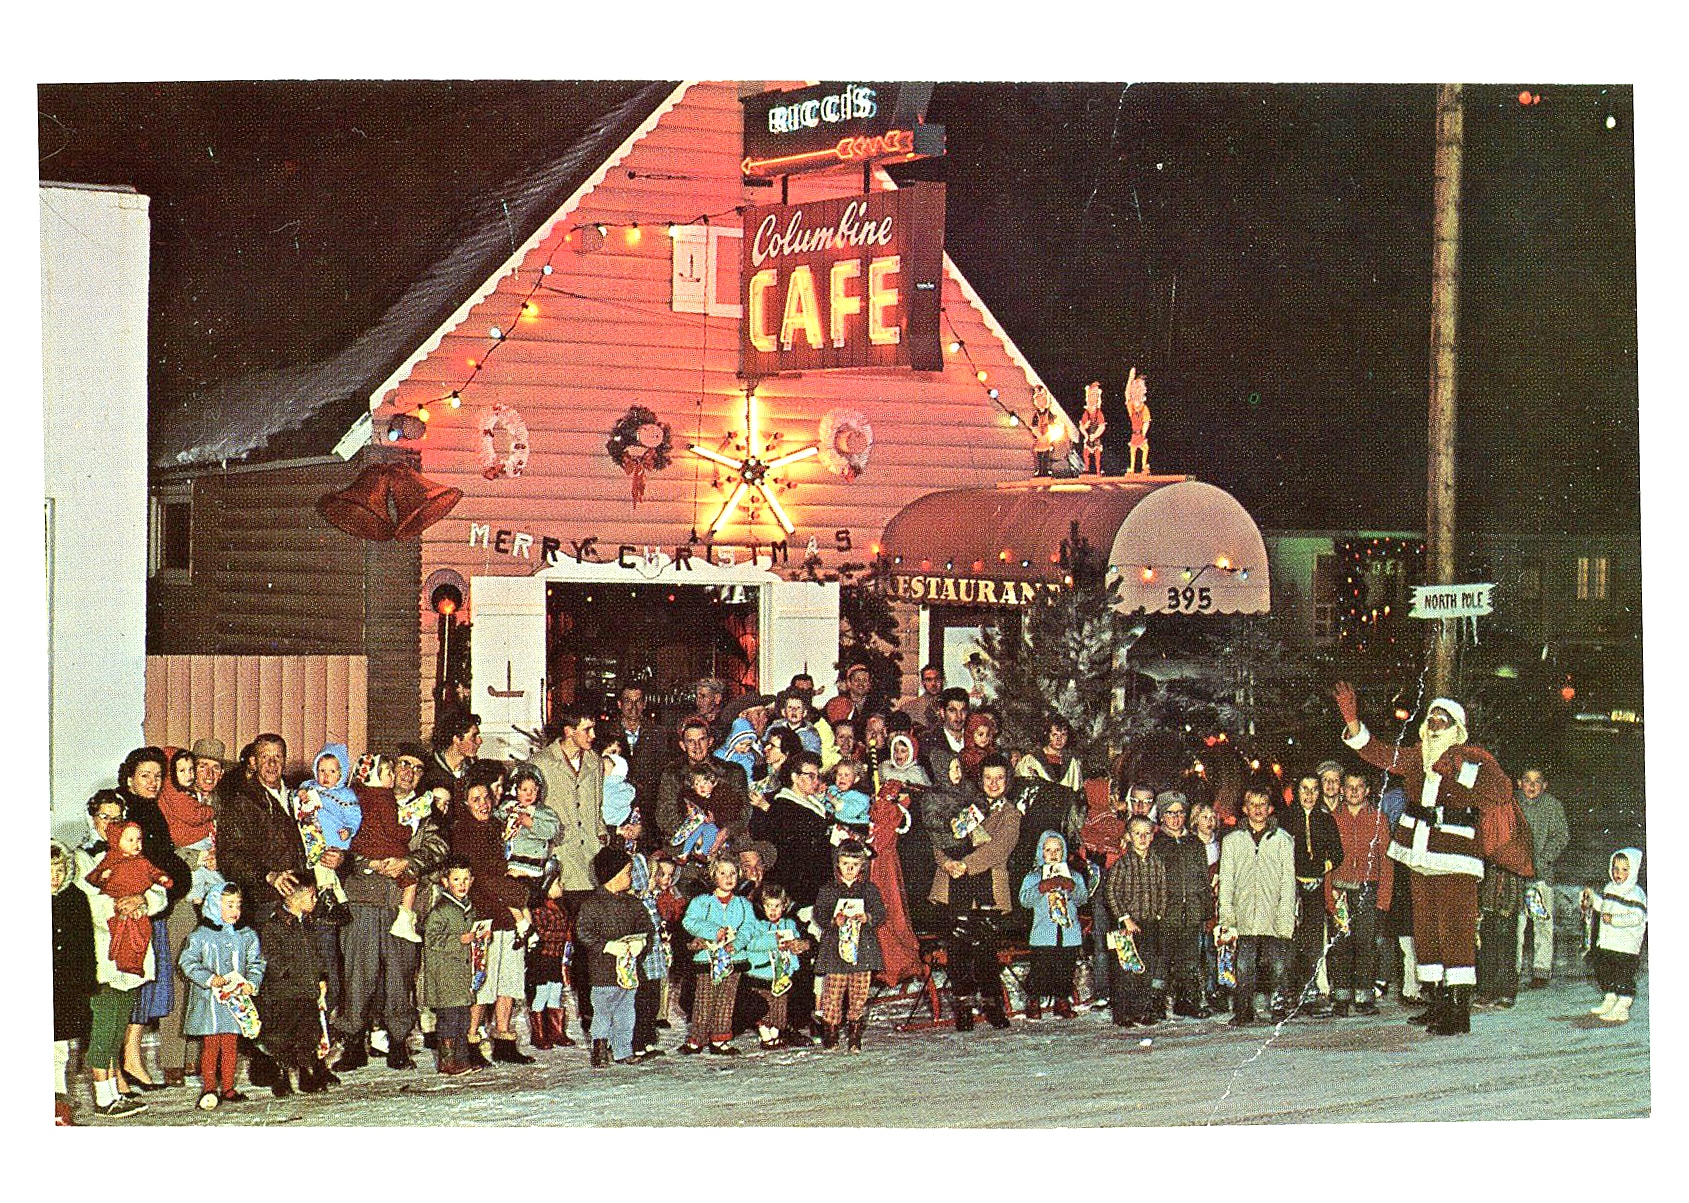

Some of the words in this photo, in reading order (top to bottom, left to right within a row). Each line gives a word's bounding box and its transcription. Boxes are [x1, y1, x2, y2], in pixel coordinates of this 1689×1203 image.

[752, 201, 893, 267] Columbine
[749, 255, 901, 352] CAFE
[469, 522, 598, 564] MERRY
[618, 529, 852, 572] CHRISTMAS
[1167, 586, 1213, 610] 395
[1424, 593, 1458, 610] NORTH
[1461, 591, 1484, 609] POLE
